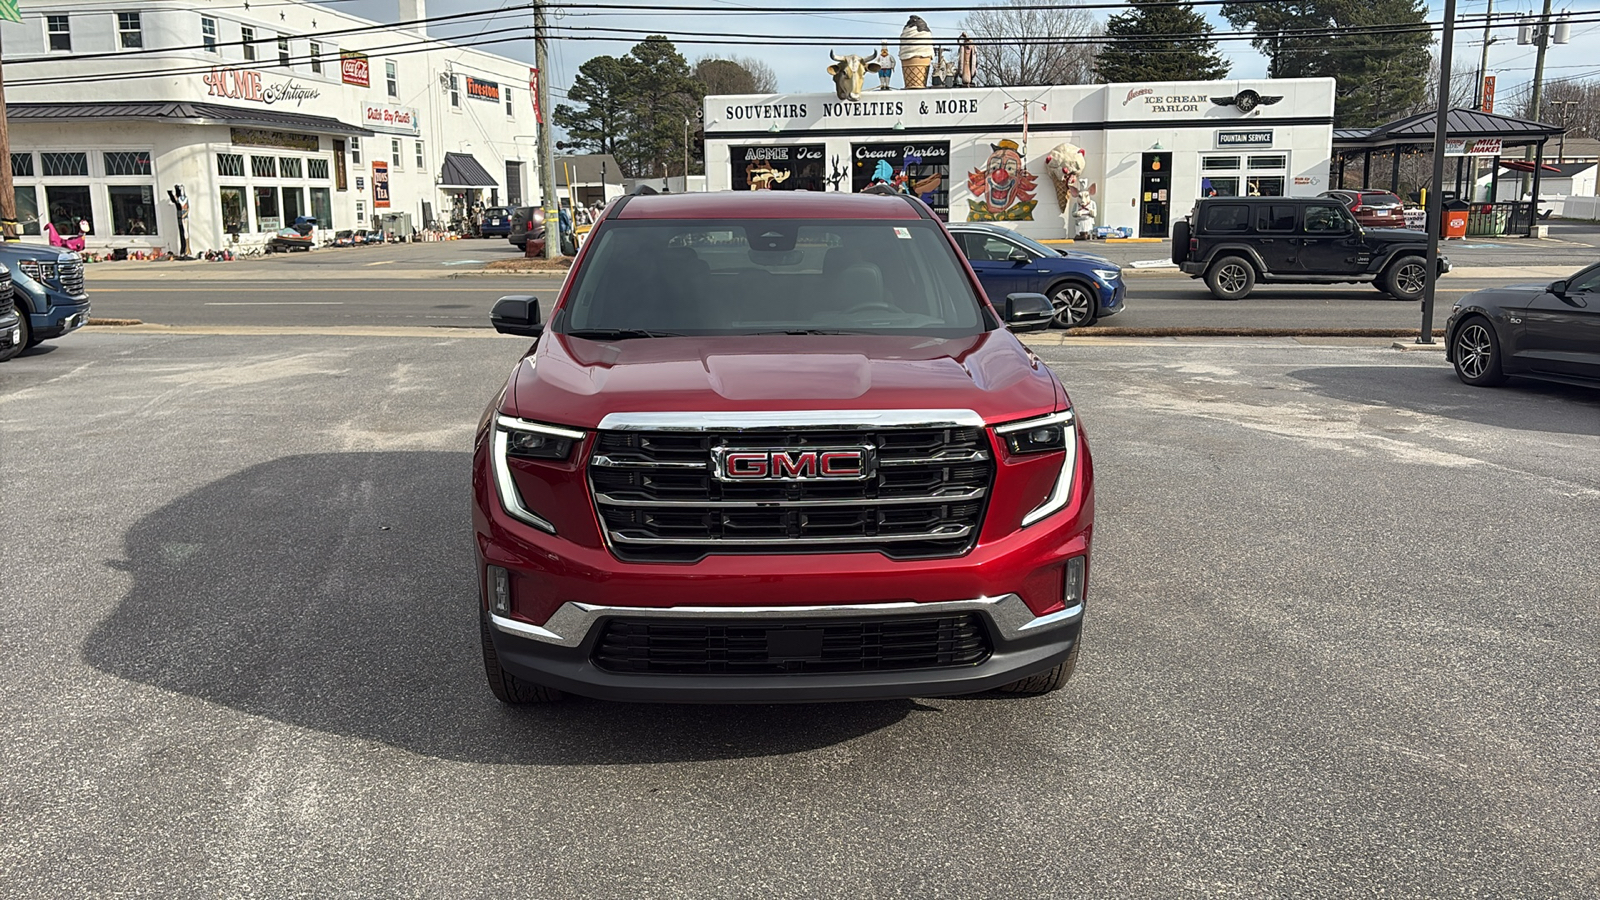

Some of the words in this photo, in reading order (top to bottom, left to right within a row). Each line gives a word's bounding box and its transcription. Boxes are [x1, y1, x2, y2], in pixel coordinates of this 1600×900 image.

[203, 65, 263, 102] ACME
[264, 78, 320, 107] Antiques
[466, 77, 499, 98] Firestone
[1166, 95, 1207, 103] CREAM
[367, 107, 382, 121] Dutch
[384, 109, 394, 125] Boy
[394, 110, 411, 123] Paints
[726, 104, 807, 119] SOUVENIRS
[823, 101, 903, 117] NOVELTIES
[919, 101, 929, 114] &
[935, 99, 978, 114] MORE
[745, 148, 789, 160] ACME
[797, 147, 822, 159] Ice
[855, 146, 897, 159] Cream
[903, 145, 947, 158] Parlor
[377, 187, 388, 199] TEA
[726, 451, 862, 478] GMC
